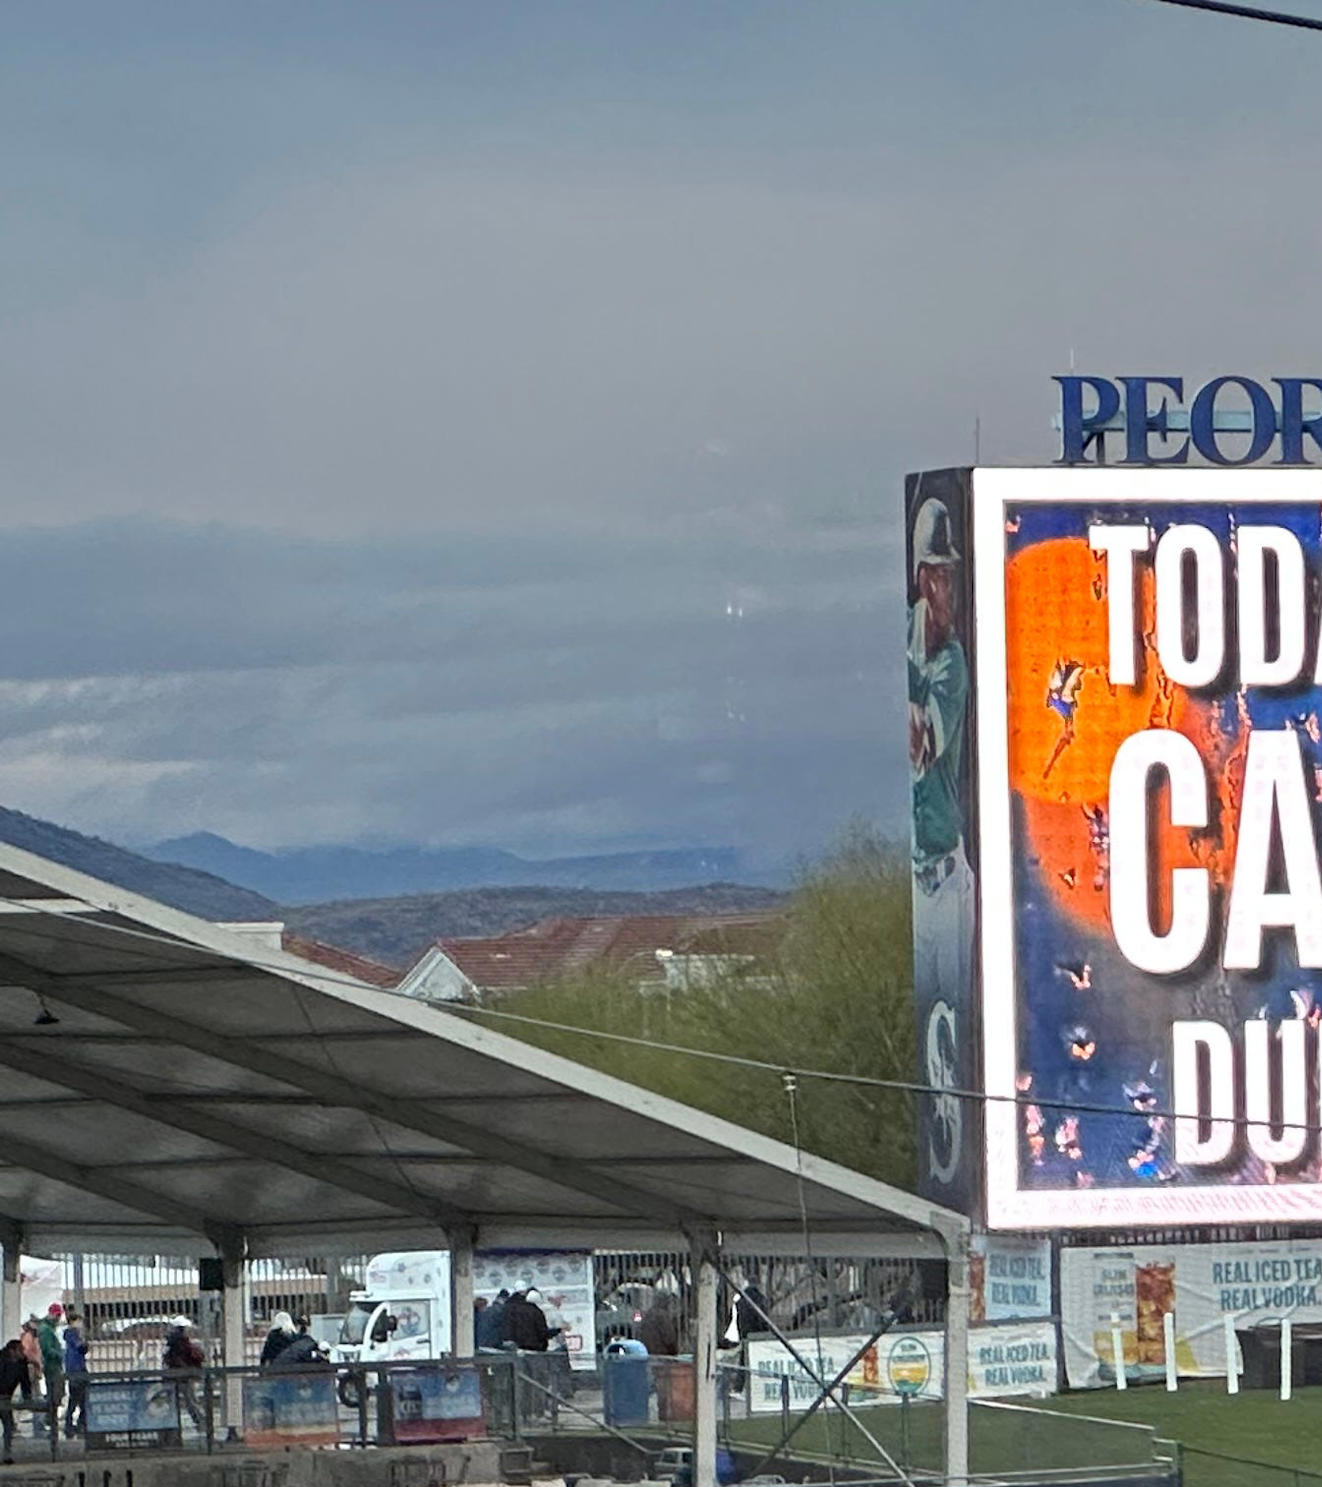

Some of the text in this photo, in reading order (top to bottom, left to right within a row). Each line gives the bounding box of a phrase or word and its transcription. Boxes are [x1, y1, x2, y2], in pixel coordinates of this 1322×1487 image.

[1212, 1262, 1250, 1285] REAL
[1255, 1260, 1291, 1282] ICED
[1220, 1288, 1260, 1310] REAL
